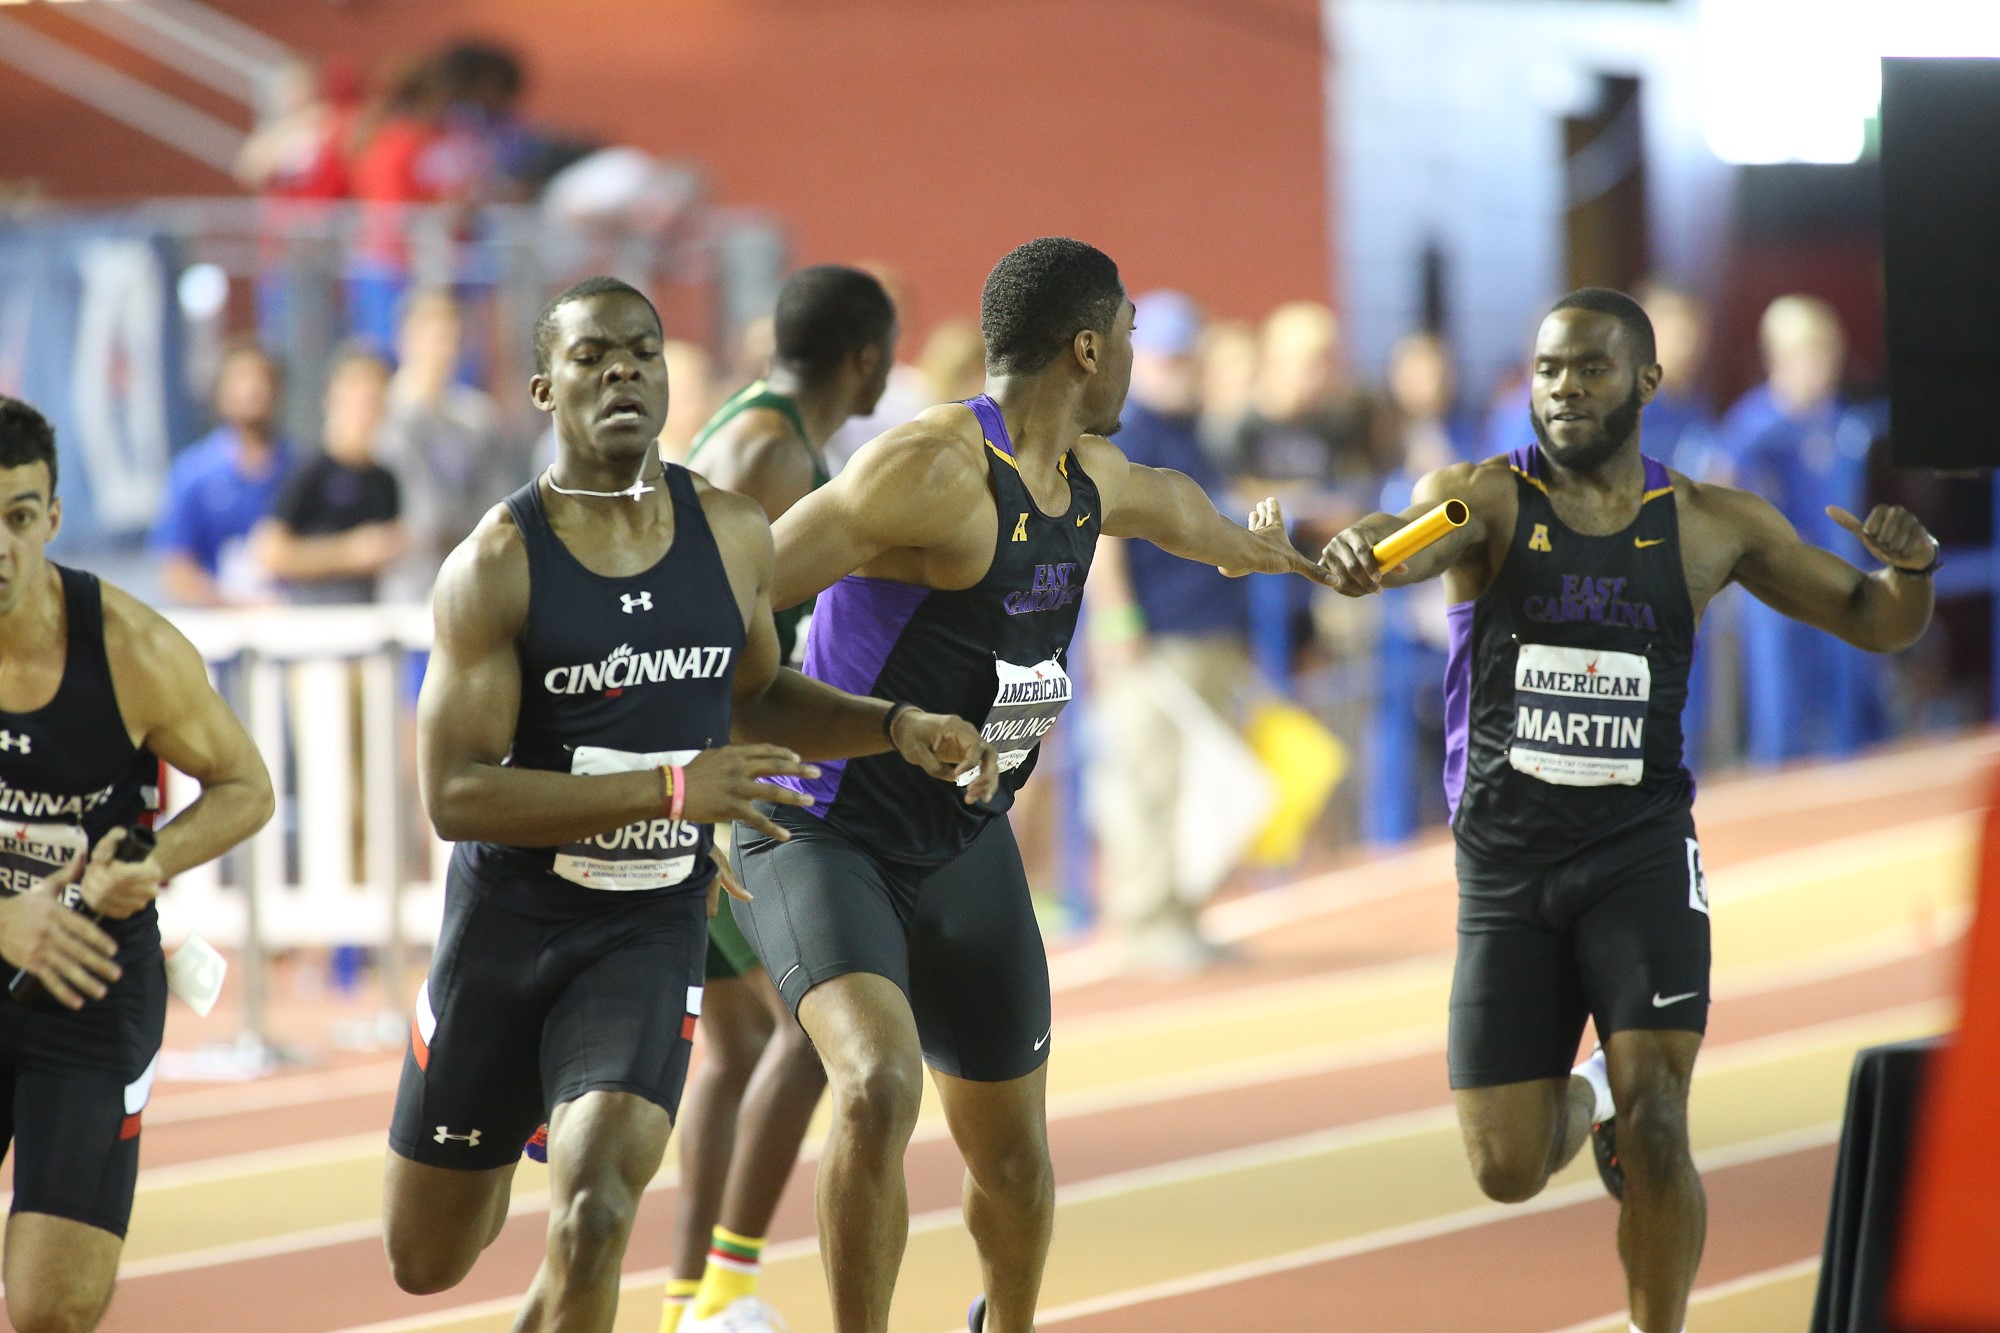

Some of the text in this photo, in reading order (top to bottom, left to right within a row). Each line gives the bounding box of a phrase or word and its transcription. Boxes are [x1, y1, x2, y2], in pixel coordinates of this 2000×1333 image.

[1032, 563, 1076, 591] EAST
[1562, 574, 1627, 603] EAST
[1523, 595, 1658, 631] CAROLINA
[543, 643, 732, 695] CINCINNATI
[1522, 669, 1641, 697] AMERICAN
[998, 677, 1067, 704] AMERICAN
[980, 717, 1057, 743] DOWLING
[1516, 706, 1644, 748] MARTIN
[576, 818, 700, 850] ORRIS
